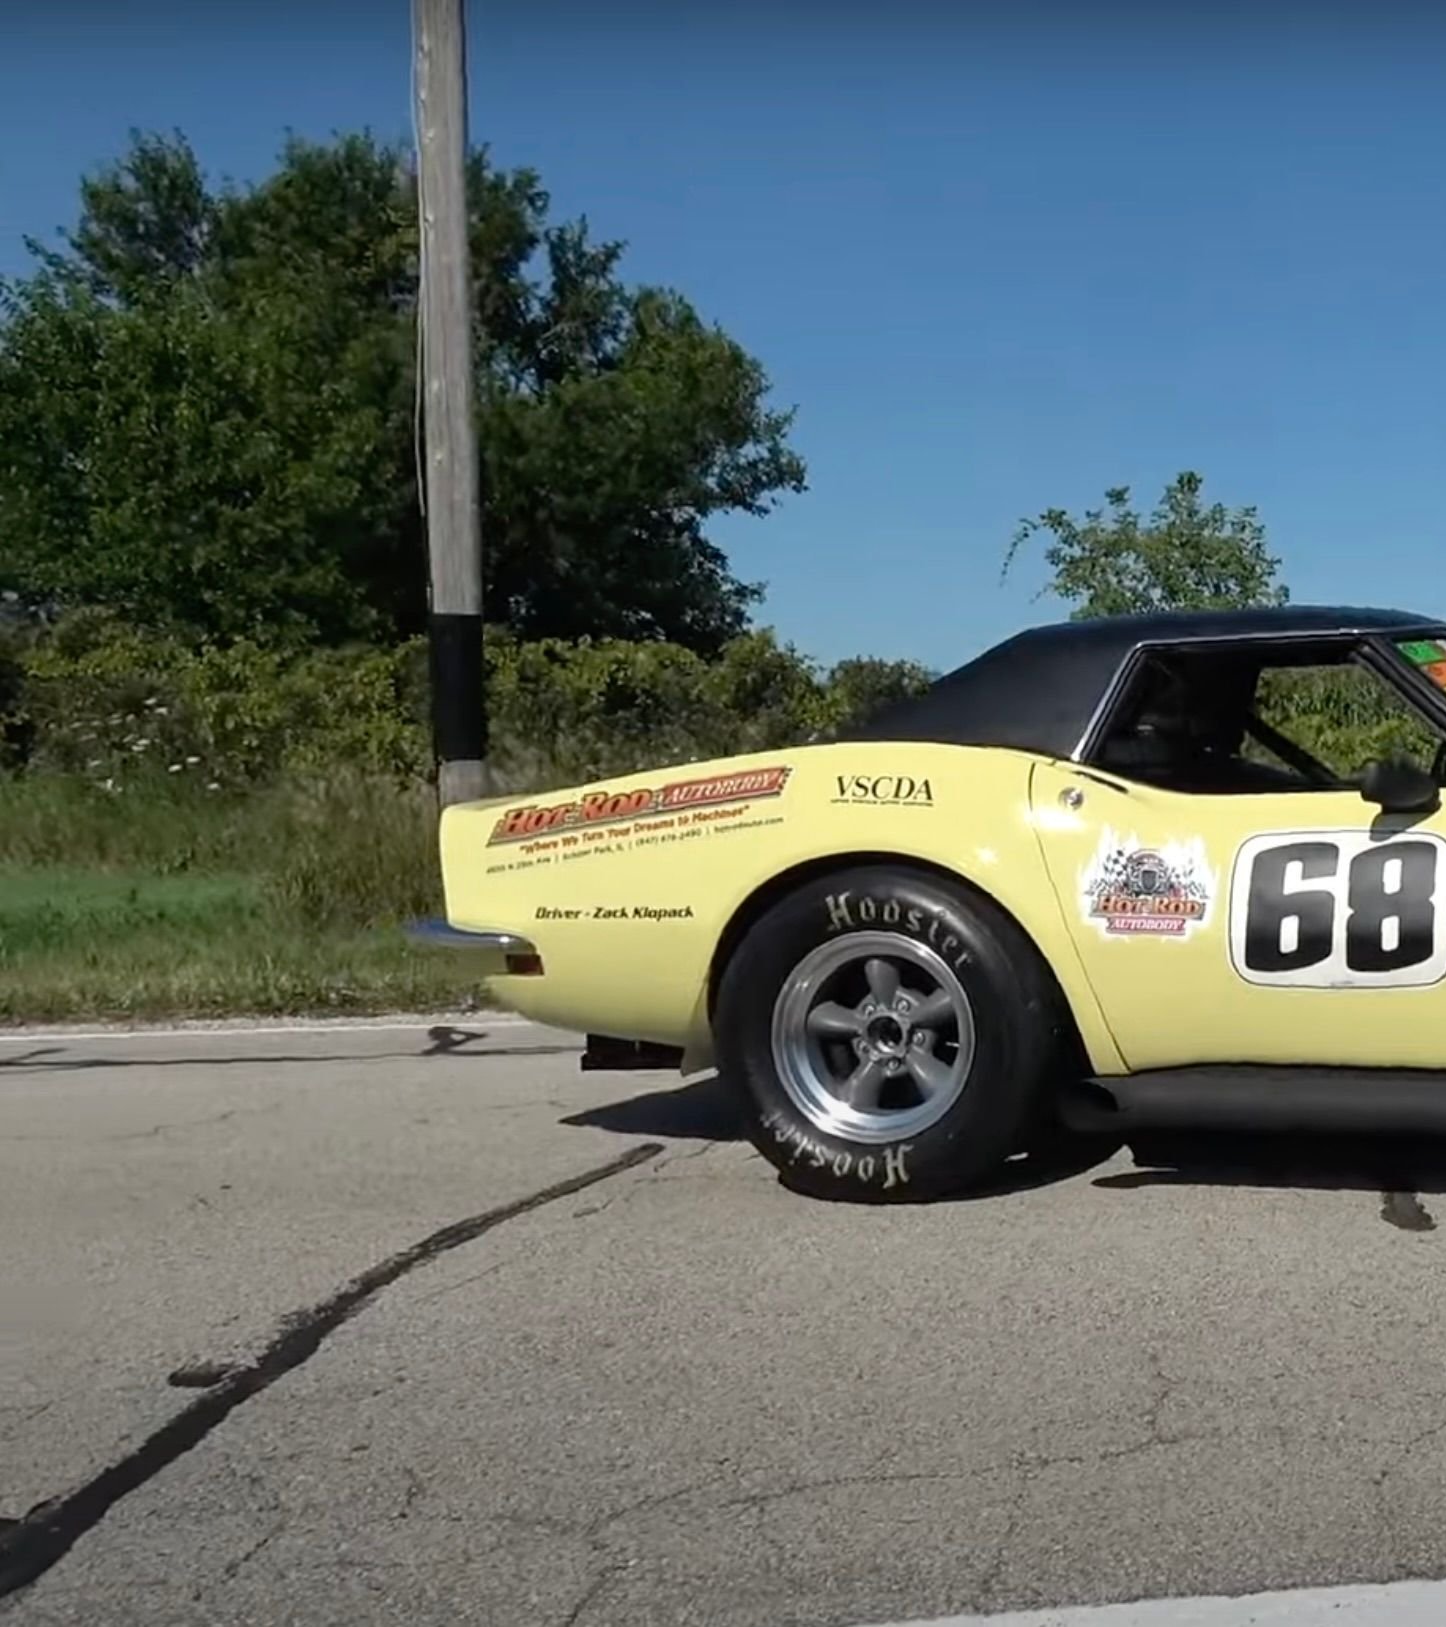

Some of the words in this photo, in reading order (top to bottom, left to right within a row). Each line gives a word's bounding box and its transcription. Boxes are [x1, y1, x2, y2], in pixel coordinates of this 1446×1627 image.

[837, 775, 934, 801] VSCDA
[582, 831, 605, 844] Turn
[634, 818, 675, 834] Dreams
[535, 906, 583, 919] Driver
[593, 906, 629, 919] Zack
[1244, 841, 1438, 972] 68
